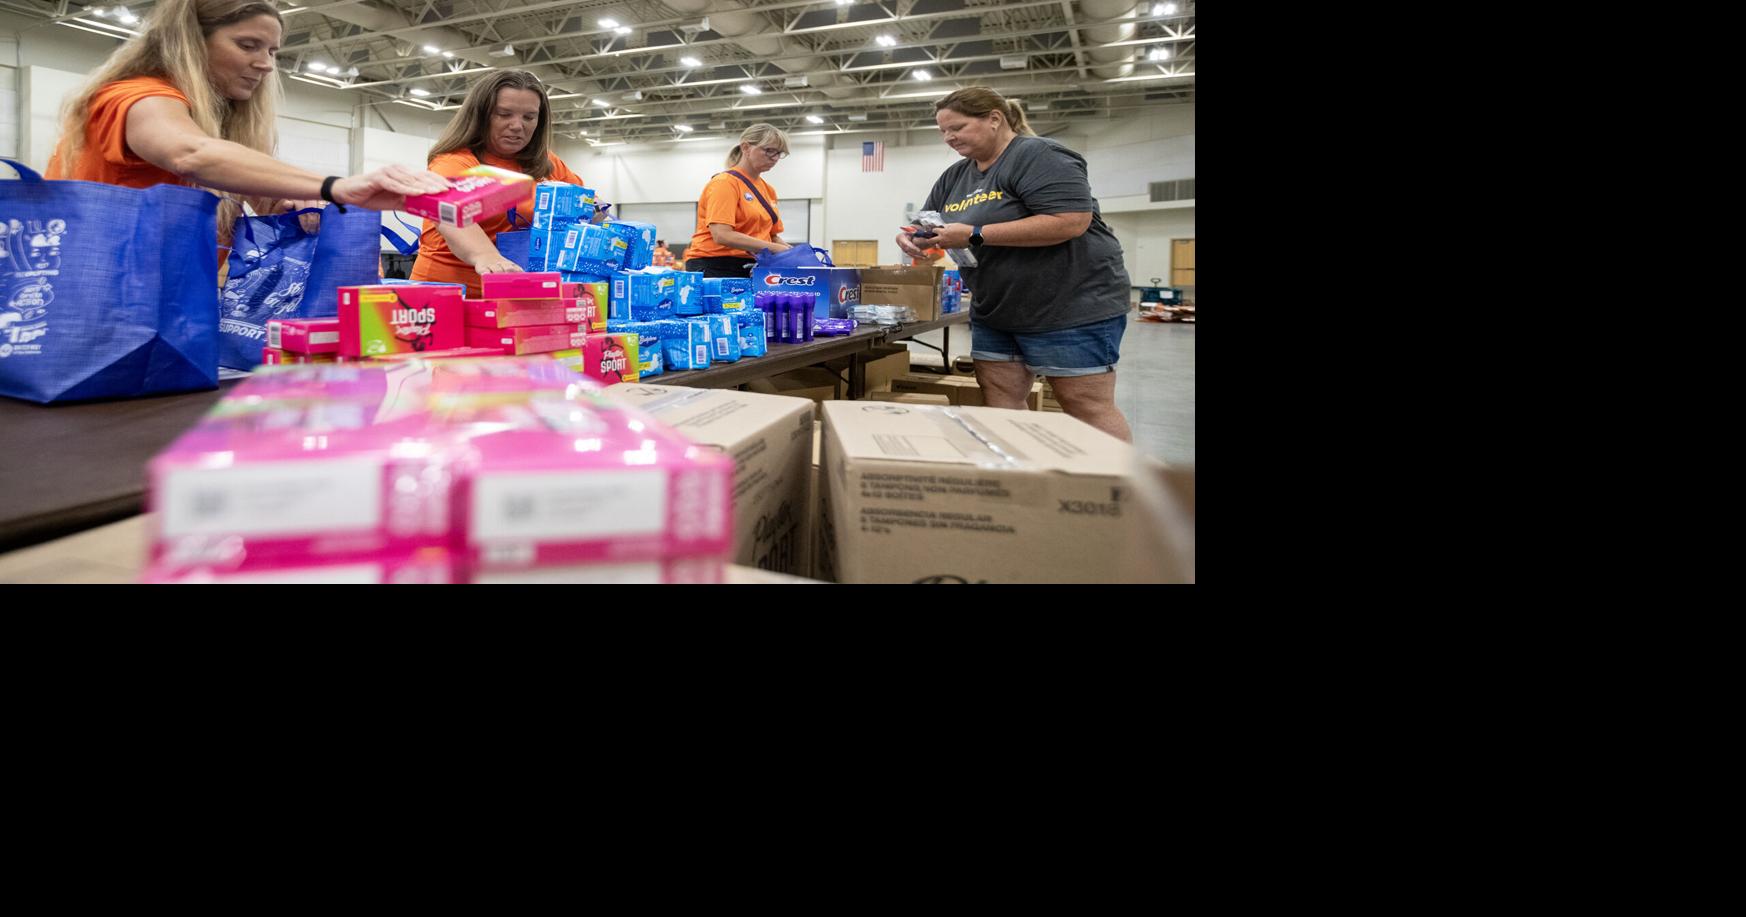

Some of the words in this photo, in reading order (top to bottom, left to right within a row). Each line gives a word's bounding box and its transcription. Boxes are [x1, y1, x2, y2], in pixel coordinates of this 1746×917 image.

[764, 274, 816, 286] Crest
[390, 308, 436, 325] SPORT
[600, 358, 627, 374] SPORT
